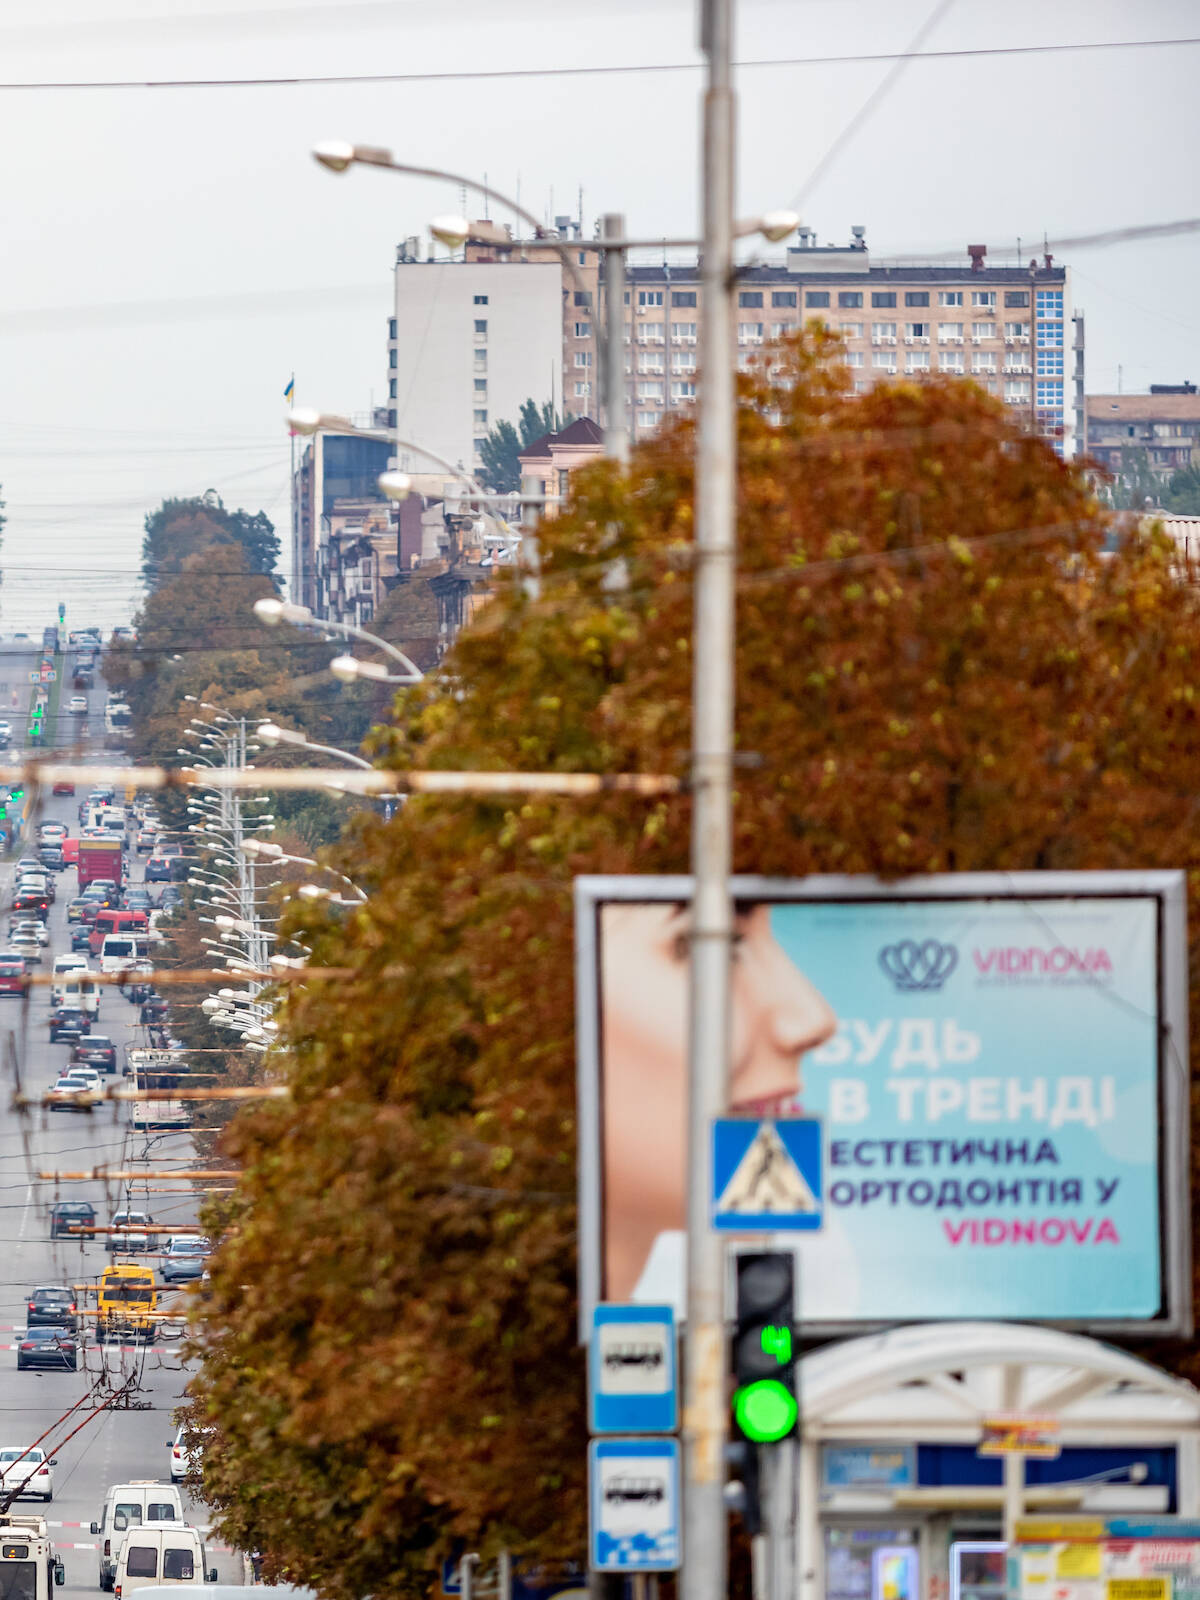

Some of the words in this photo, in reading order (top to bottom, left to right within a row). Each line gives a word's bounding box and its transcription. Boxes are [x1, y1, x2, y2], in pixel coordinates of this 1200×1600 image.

[813, 1018, 982, 1069] БУДЬ
[830, 1077, 870, 1122] В
[885, 1076, 1116, 1128] ТРЕНДІ
[830, 1138, 1061, 1167] ЕСТЕТИЧНА
[829, 1178, 1083, 1211] ОРТОДОНТІЯ
[1096, 1177, 1121, 1206] У
[942, 1217, 1121, 1247] VIDNOVA
